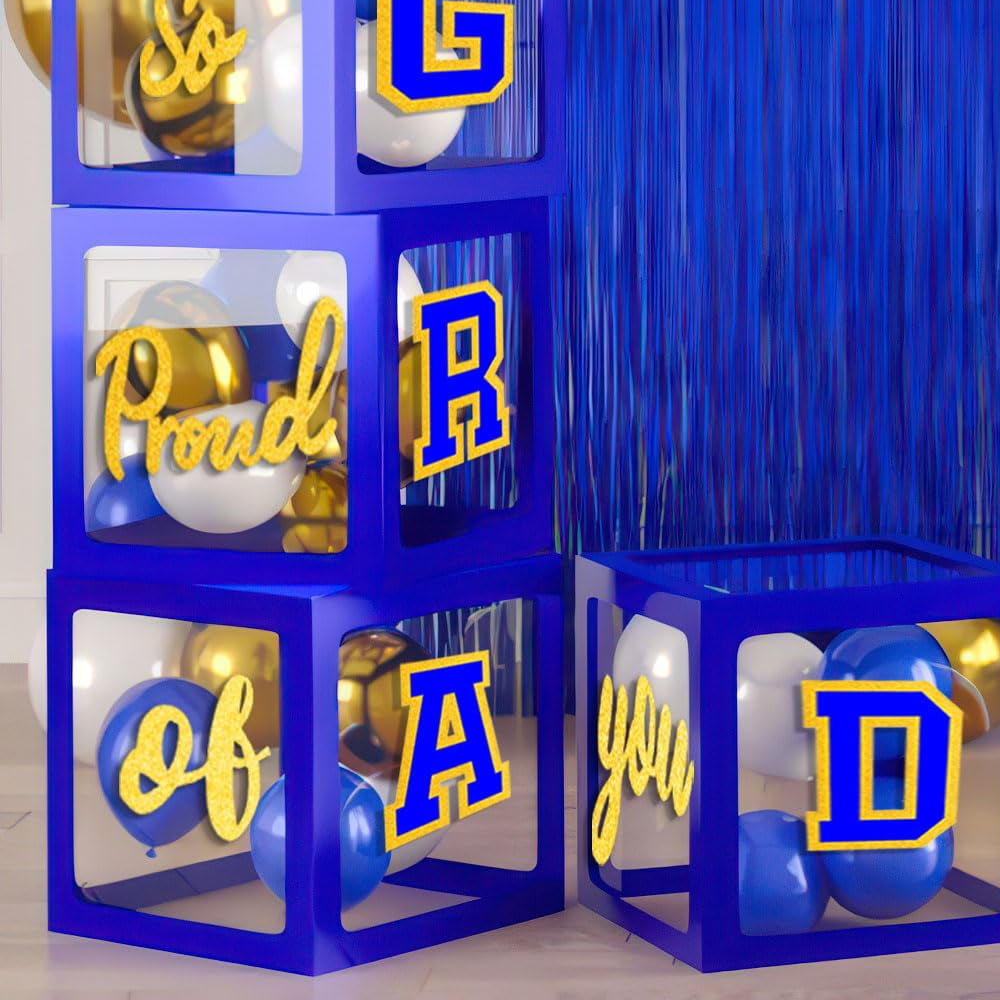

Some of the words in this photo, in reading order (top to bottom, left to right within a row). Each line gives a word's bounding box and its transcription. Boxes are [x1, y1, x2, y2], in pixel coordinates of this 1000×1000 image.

[96, 296, 337, 481] Proud
[413, 280, 510, 482] R
[119, 674, 271, 842] of
[385, 650, 511, 852] A
[592, 674, 694, 865] you
[802, 680, 964, 852] D
